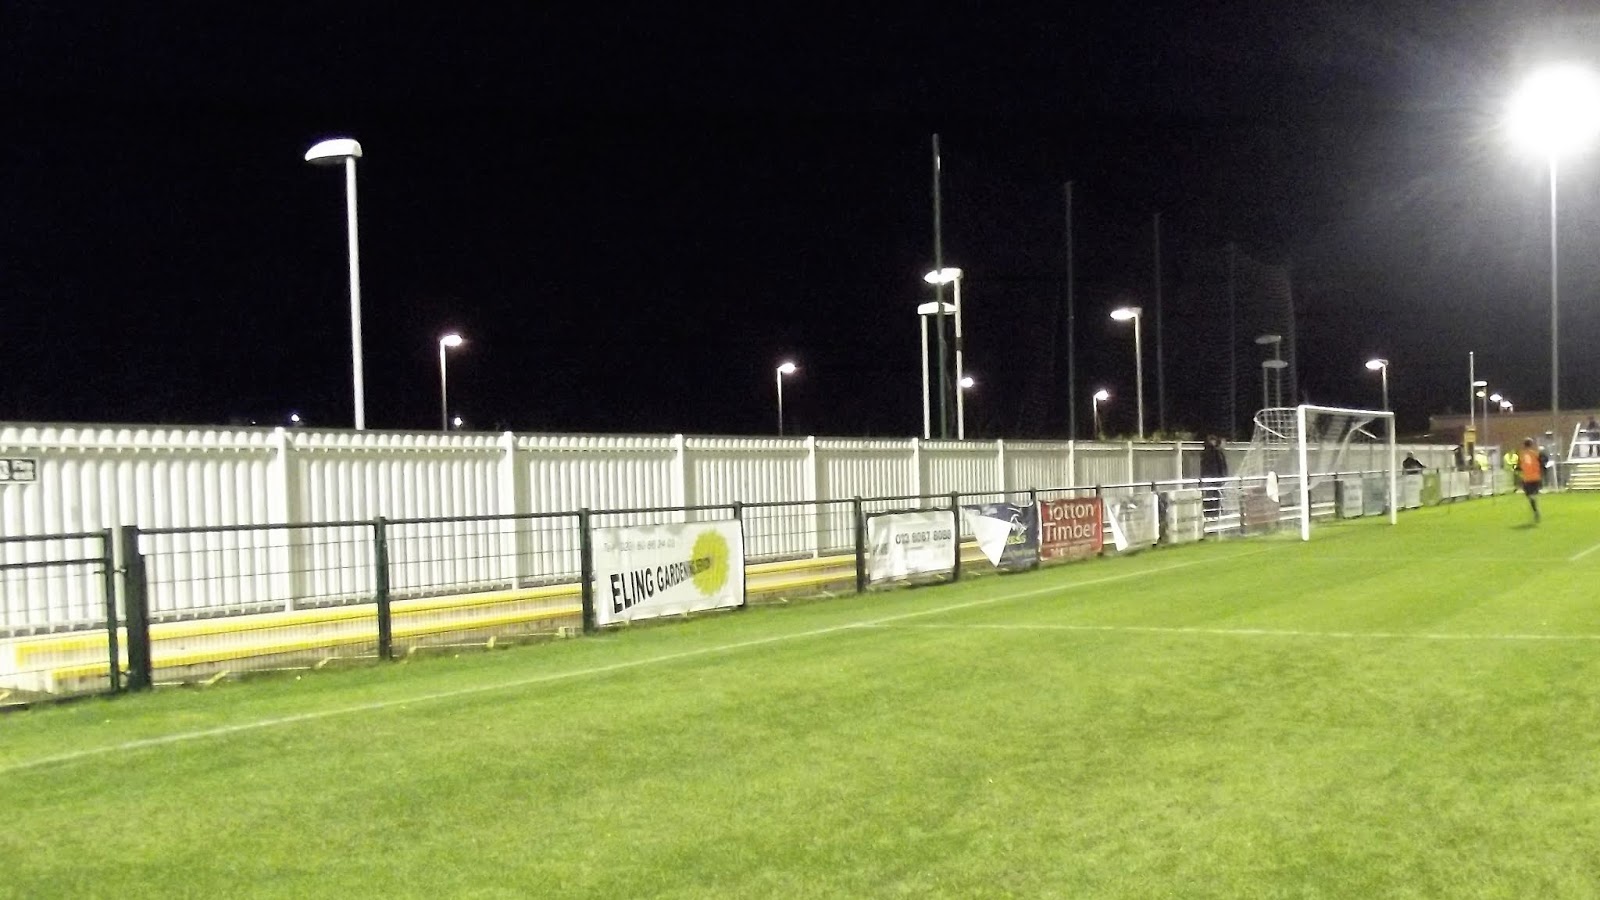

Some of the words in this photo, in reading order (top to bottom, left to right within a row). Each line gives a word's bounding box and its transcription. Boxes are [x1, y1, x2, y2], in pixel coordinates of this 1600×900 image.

[1045, 503, 1094, 520] Totton
[1043, 519, 1097, 542] Timber
[610, 567, 654, 614] ELING
